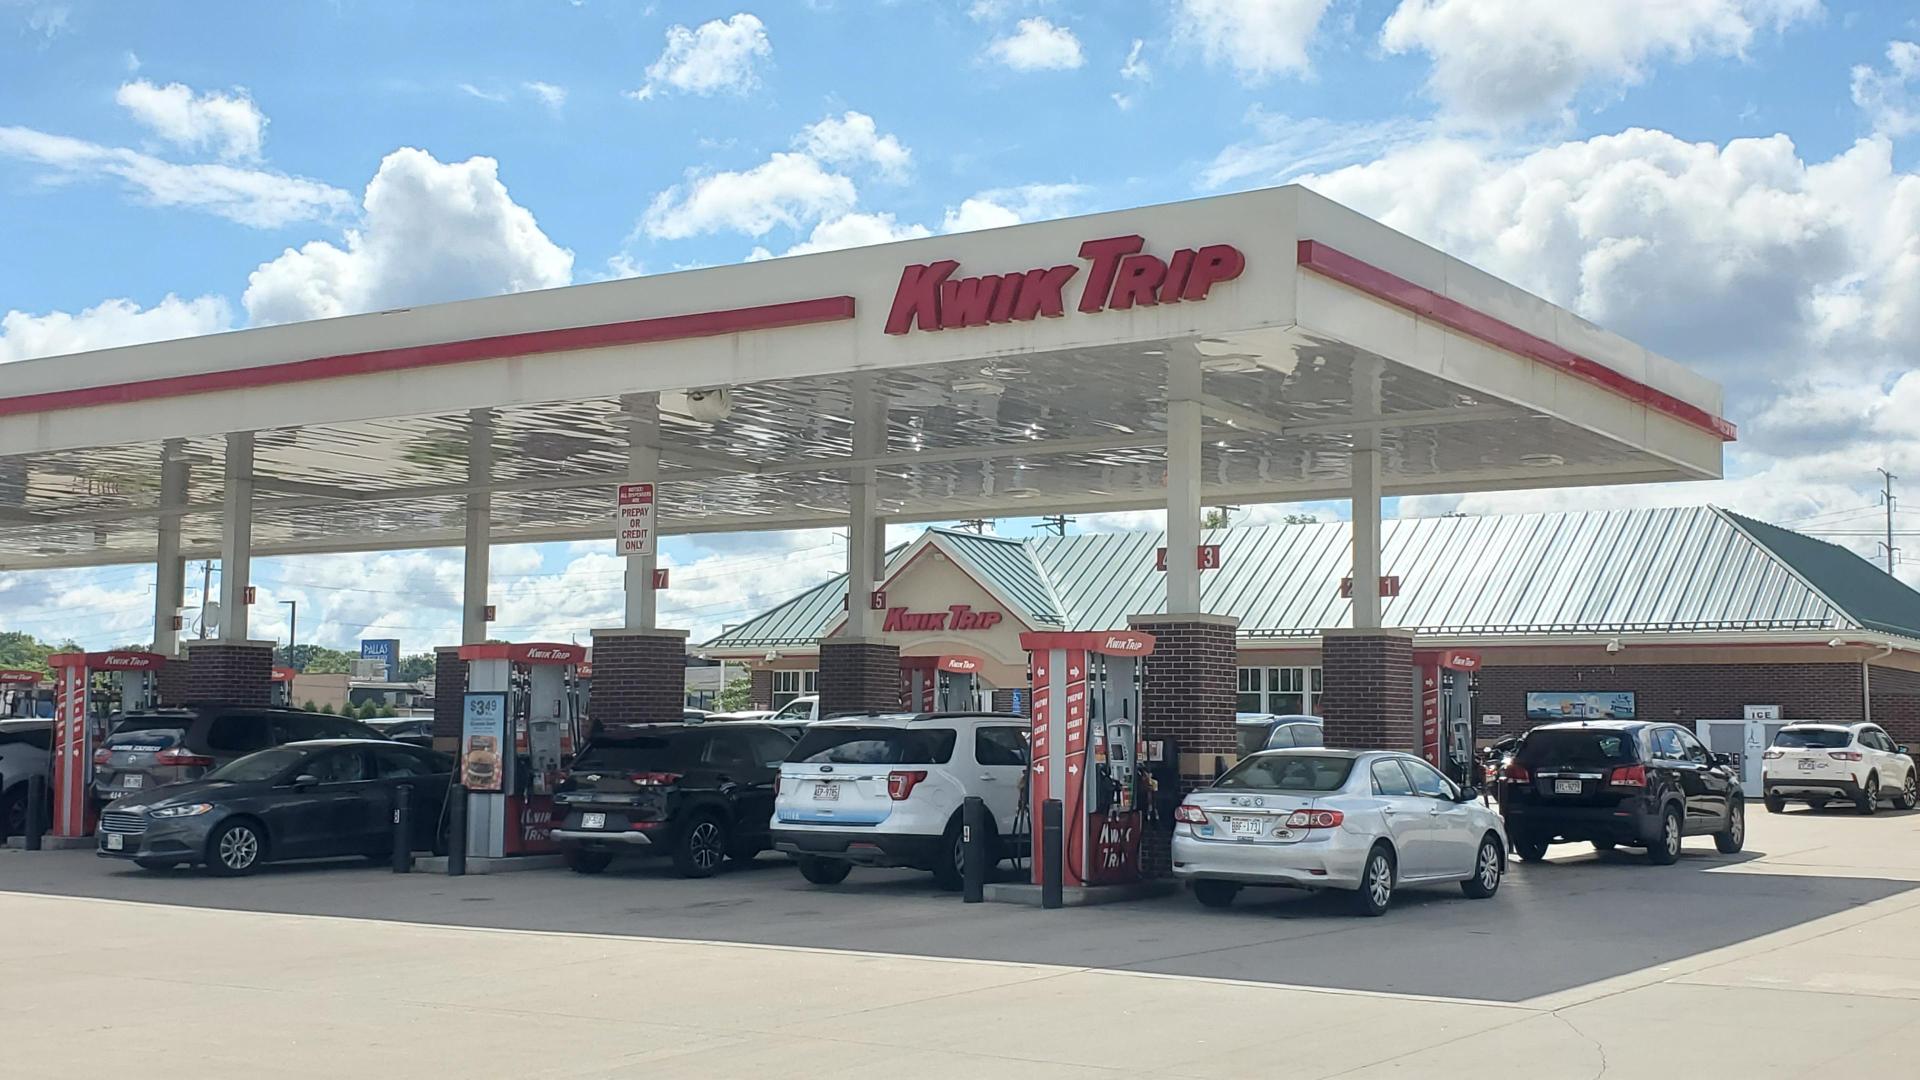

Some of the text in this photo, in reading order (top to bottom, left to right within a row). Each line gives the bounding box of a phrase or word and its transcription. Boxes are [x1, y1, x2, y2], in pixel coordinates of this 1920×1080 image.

[884, 234, 1246, 335] KWIK TRIP
[621, 507, 650, 518] PREPAY
[630, 519, 641, 528] OR
[621, 529, 649, 539] CREDIT
[625, 541, 645, 551] ONLY
[1204, 547, 1213, 567] 3
[657, 570, 665, 587] 7
[1385, 578, 1391, 595] 1
[245, 588, 254, 604] 11
[875, 593, 882, 608] 5
[882, 604, 1003, 632] KWIK TRIP
[364, 643, 388, 655] PALLAS
[1751, 711, 1771, 719] ICE
